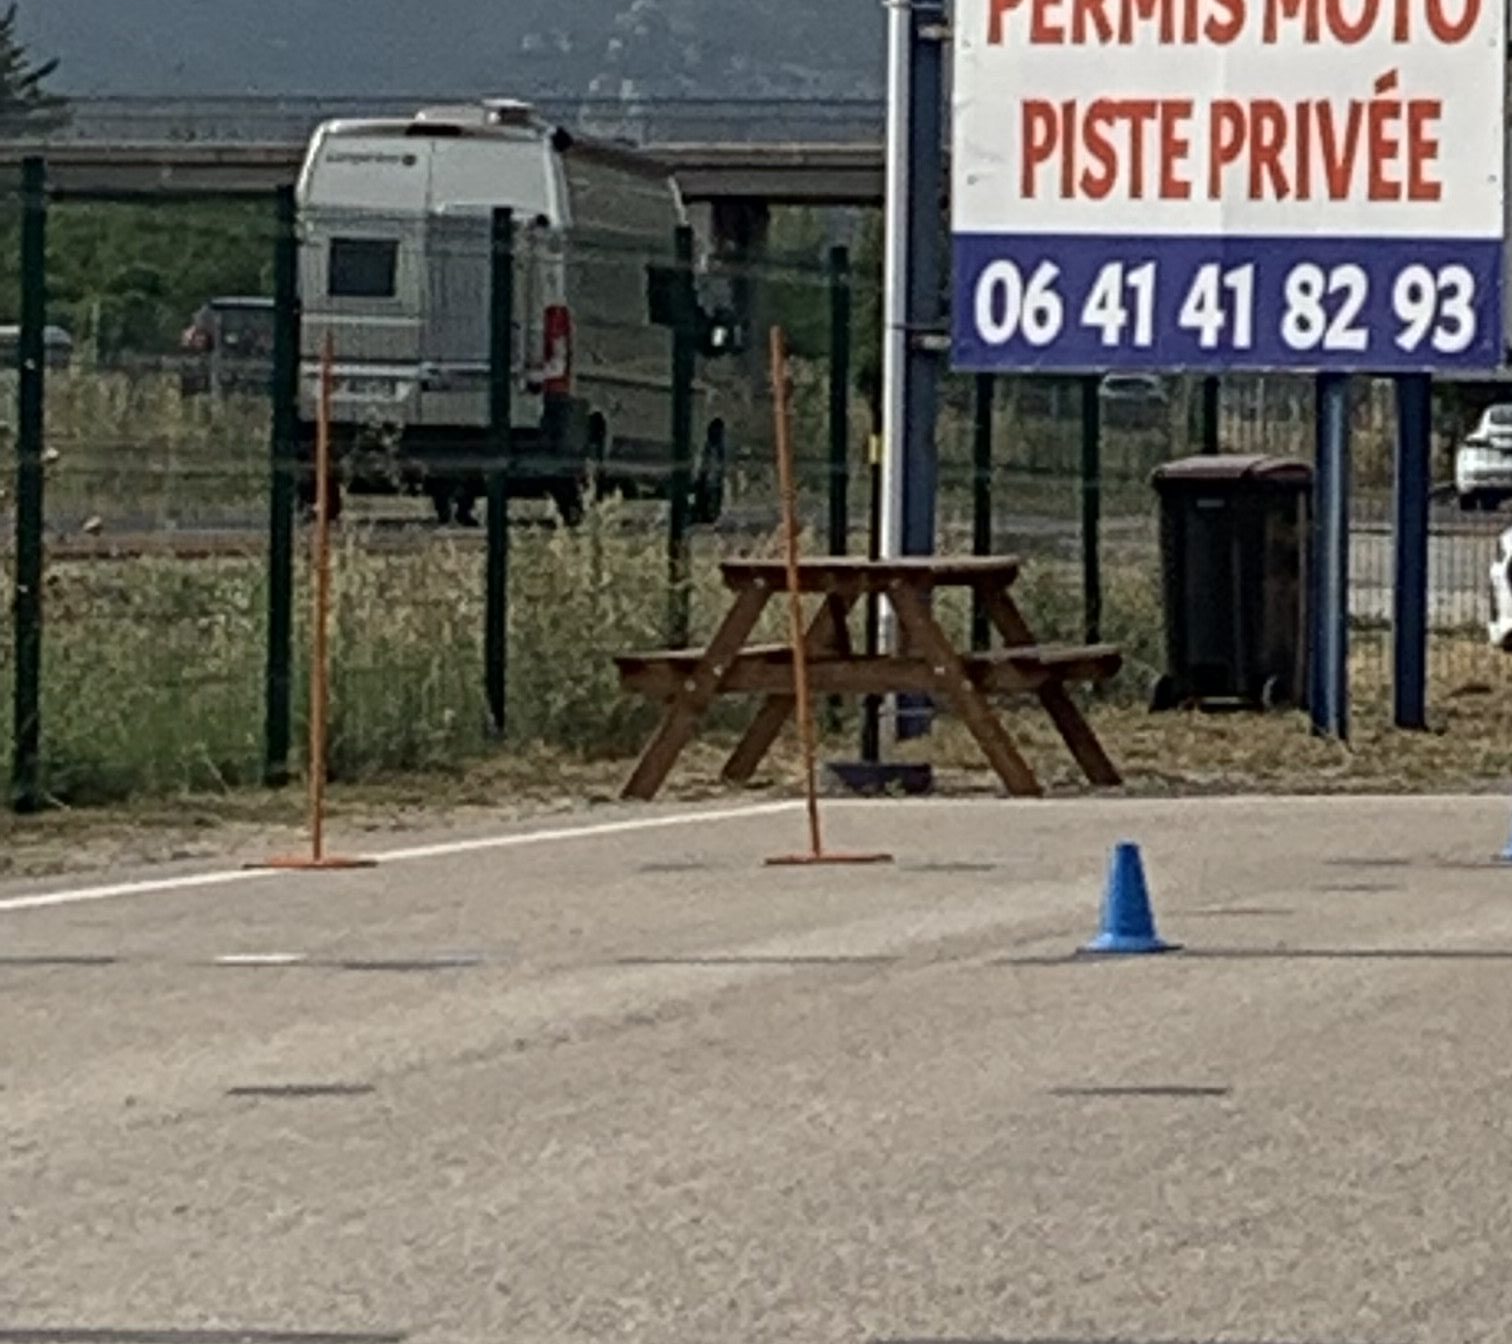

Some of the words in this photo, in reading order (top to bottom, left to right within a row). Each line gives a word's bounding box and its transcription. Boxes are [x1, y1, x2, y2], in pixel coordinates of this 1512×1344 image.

[1020, 98, 1194, 201] PISTE
[1208, 67, 1442, 202] PRIVÉE
[975, 259, 1064, 346] 06
[1080, 261, 1156, 347] 41
[1178, 262, 1255, 349] 41
[1281, 262, 1369, 351] 82
[1394, 263, 1477, 354] 93
